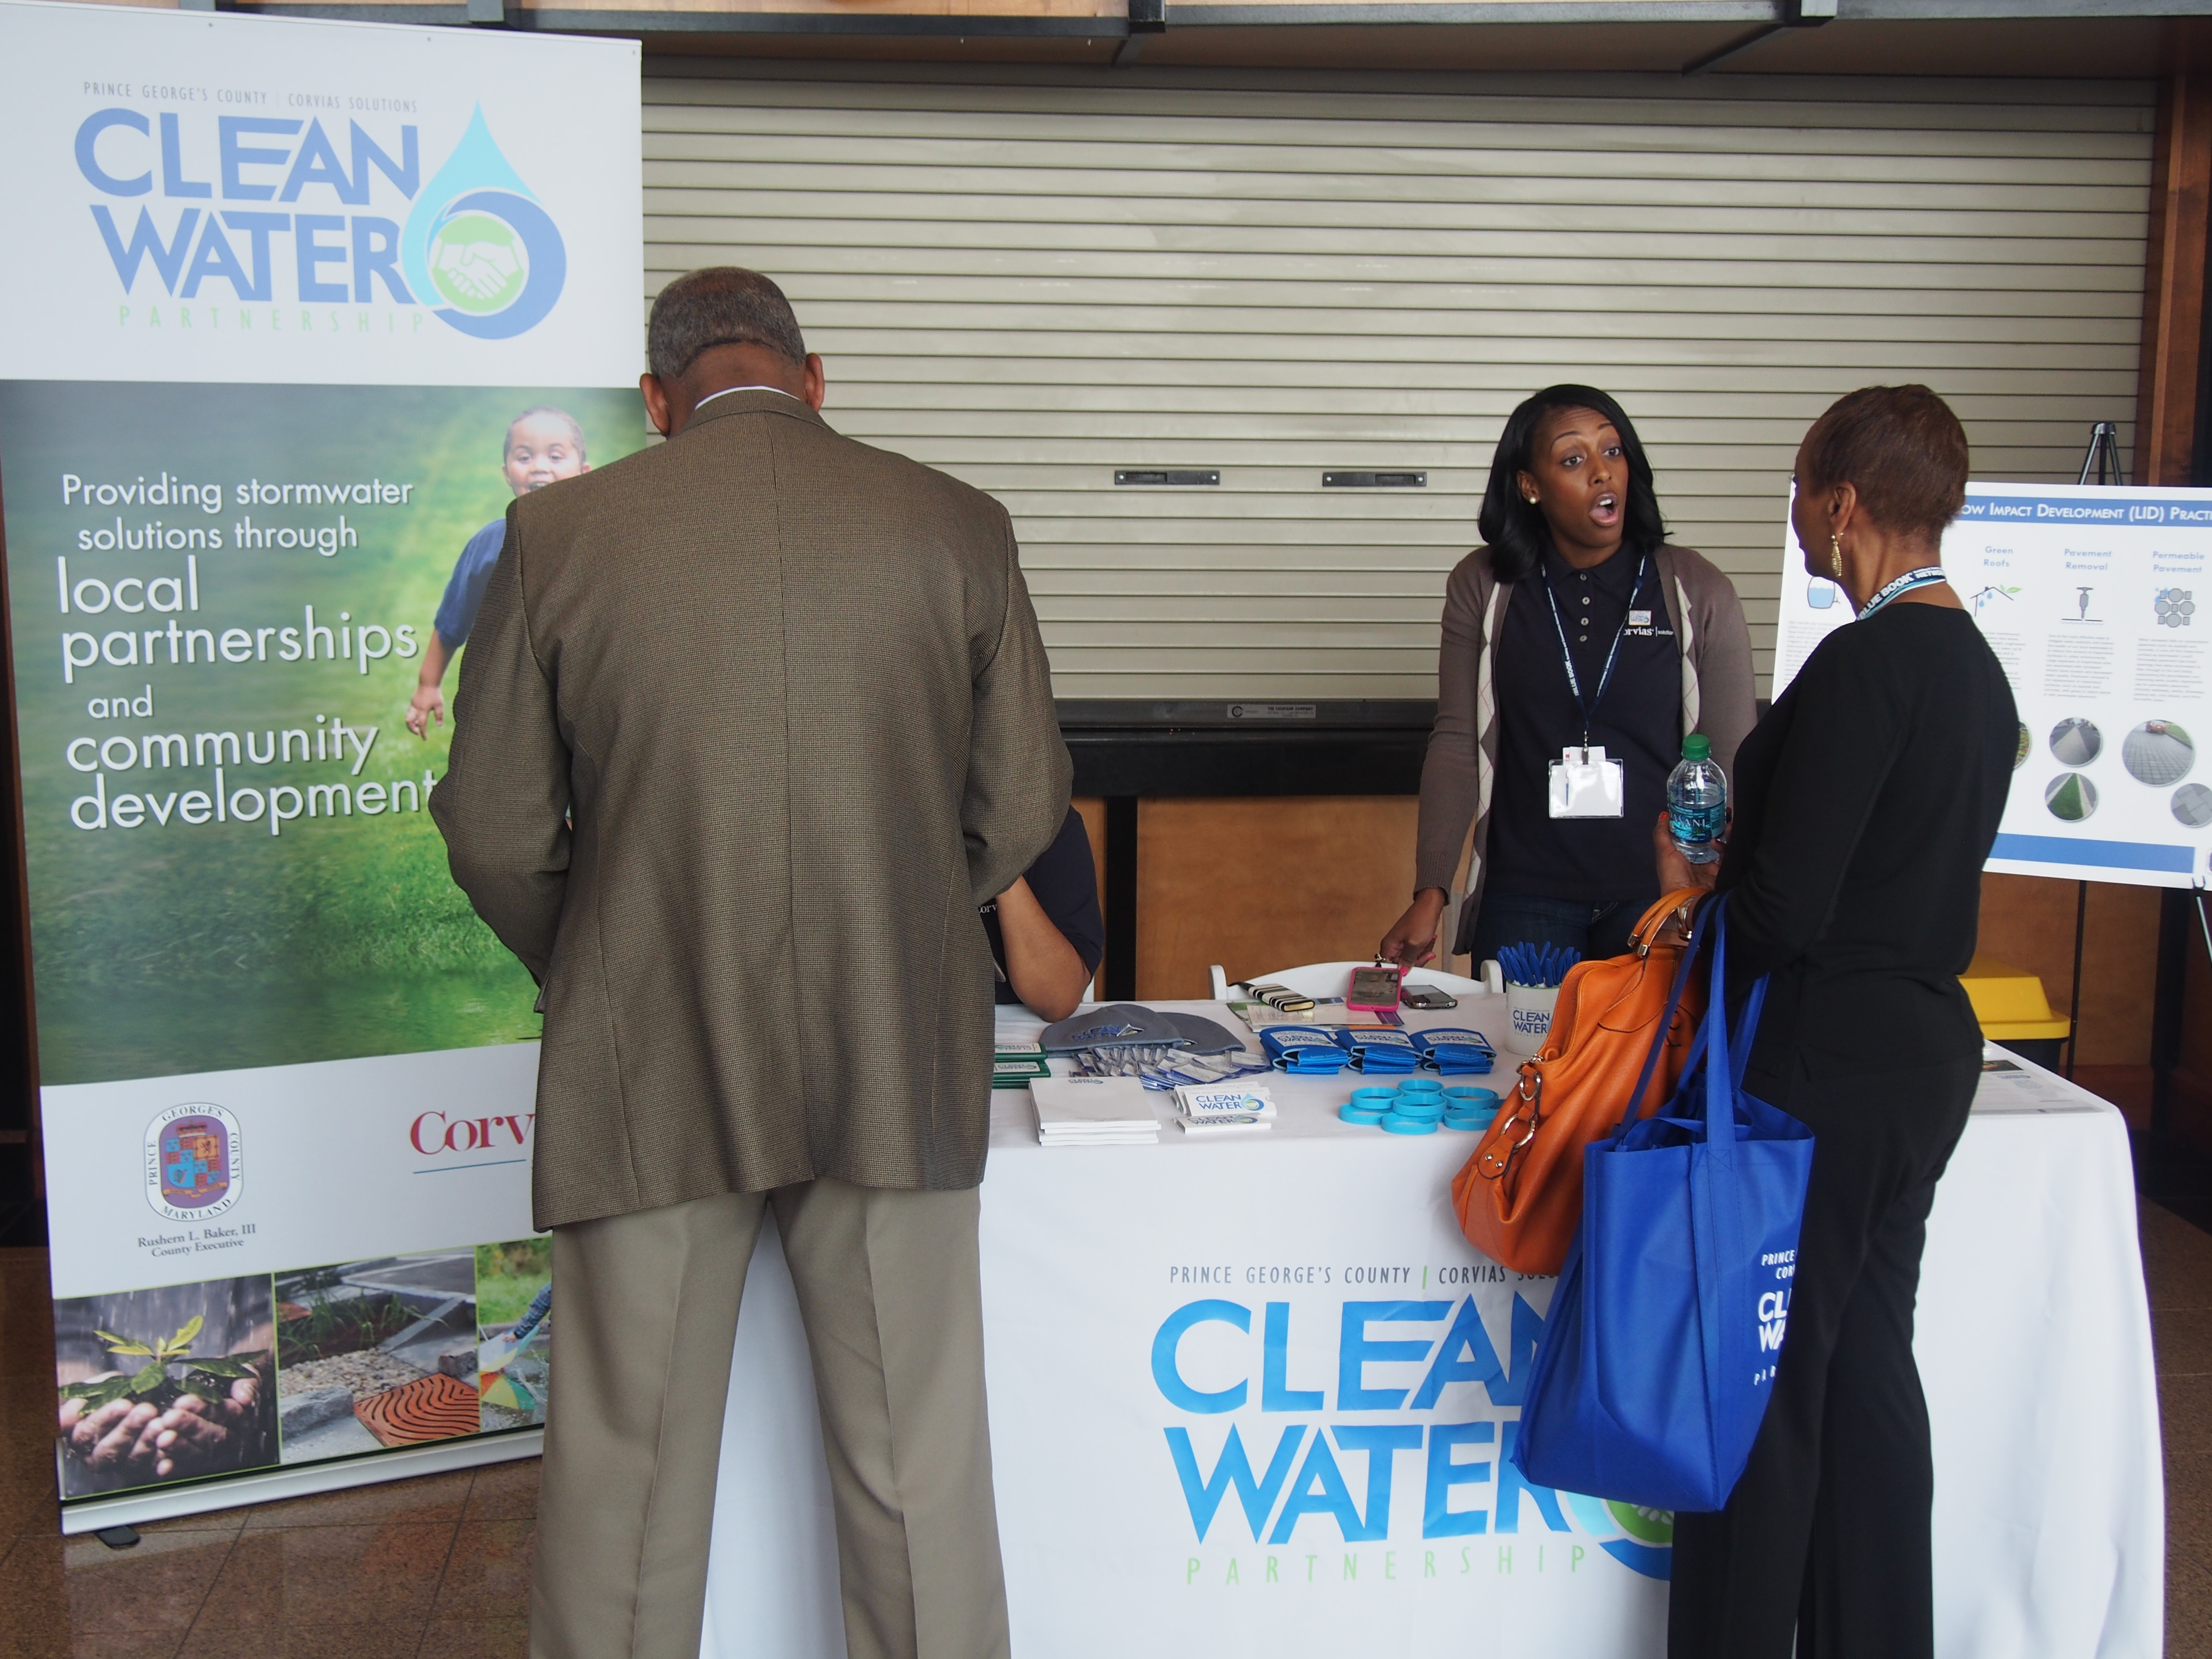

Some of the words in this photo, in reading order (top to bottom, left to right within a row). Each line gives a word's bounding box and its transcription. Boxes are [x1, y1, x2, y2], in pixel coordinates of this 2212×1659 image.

[84, 81, 132, 97] PRINCE
[143, 85, 208, 101] GEORGE'S
[217, 89, 266, 104] COUNTY
[289, 93, 340, 108] CORVIAS
[349, 96, 418, 113] SOLUTIONS
[74, 108, 420, 205] CLEAN
[89, 204, 418, 304] WATER
[119, 305, 423, 333] PARTNERSHIP
[62, 471, 222, 514] Providing
[236, 479, 414, 505] stormwater
[2128, 505, 2164, 523] (LID)
[78, 517, 223, 551] solutions
[235, 516, 358, 557] through
[1984, 546, 2013, 554] Green
[2064, 548, 2112, 557] Pavement
[2152, 551, 2205, 560] Permeable
[1984, 559, 2010, 567] Roofs
[2065, 562, 2108, 570] Removal
[2153, 564, 2202, 573] Pavement
[58, 555, 199, 613] local
[1859, 593, 1883, 620] BLUE
[1880, 572, 1915, 597] BOOK
[62, 605, 419, 684] partnerships
[88, 684, 153, 719] and
[67, 714, 379, 775] community
[71, 768, 438, 836] development
[979, 904, 997, 914] orv
[1513, 1010, 1550, 1022] CLEAN
[1513, 1020, 1548, 1034] WATER
[1196, 1094, 1241, 1103] CLEAN
[1198, 1102, 1242, 1110] WATER
[147, 1140, 158, 1186] PRINCE
[229, 1132, 240, 1180] COUNTY
[163, 1198, 232, 1220] MARYLAND
[137, 1235, 185, 1248] Rushern
[189, 1231, 200, 1241] L.
[204, 1227, 238, 1239] Baker,
[241, 1224, 256, 1235] III
[151, 1246, 192, 1257] County
[195, 1238, 244, 1251] Executive
[1761, 1249, 1795, 1266] PRINCE
[1169, 1266, 1233, 1284] PRINCE
[1246, 1266, 1332, 1285] GEORGE'S
[1344, 1266, 1411, 1285] COUNTY
[1438, 1265, 1506, 1285] CORVIAS
[1758, 1287, 1791, 1322] CL
[1187, 1543, 1586, 1586] PARTNERSHIP
